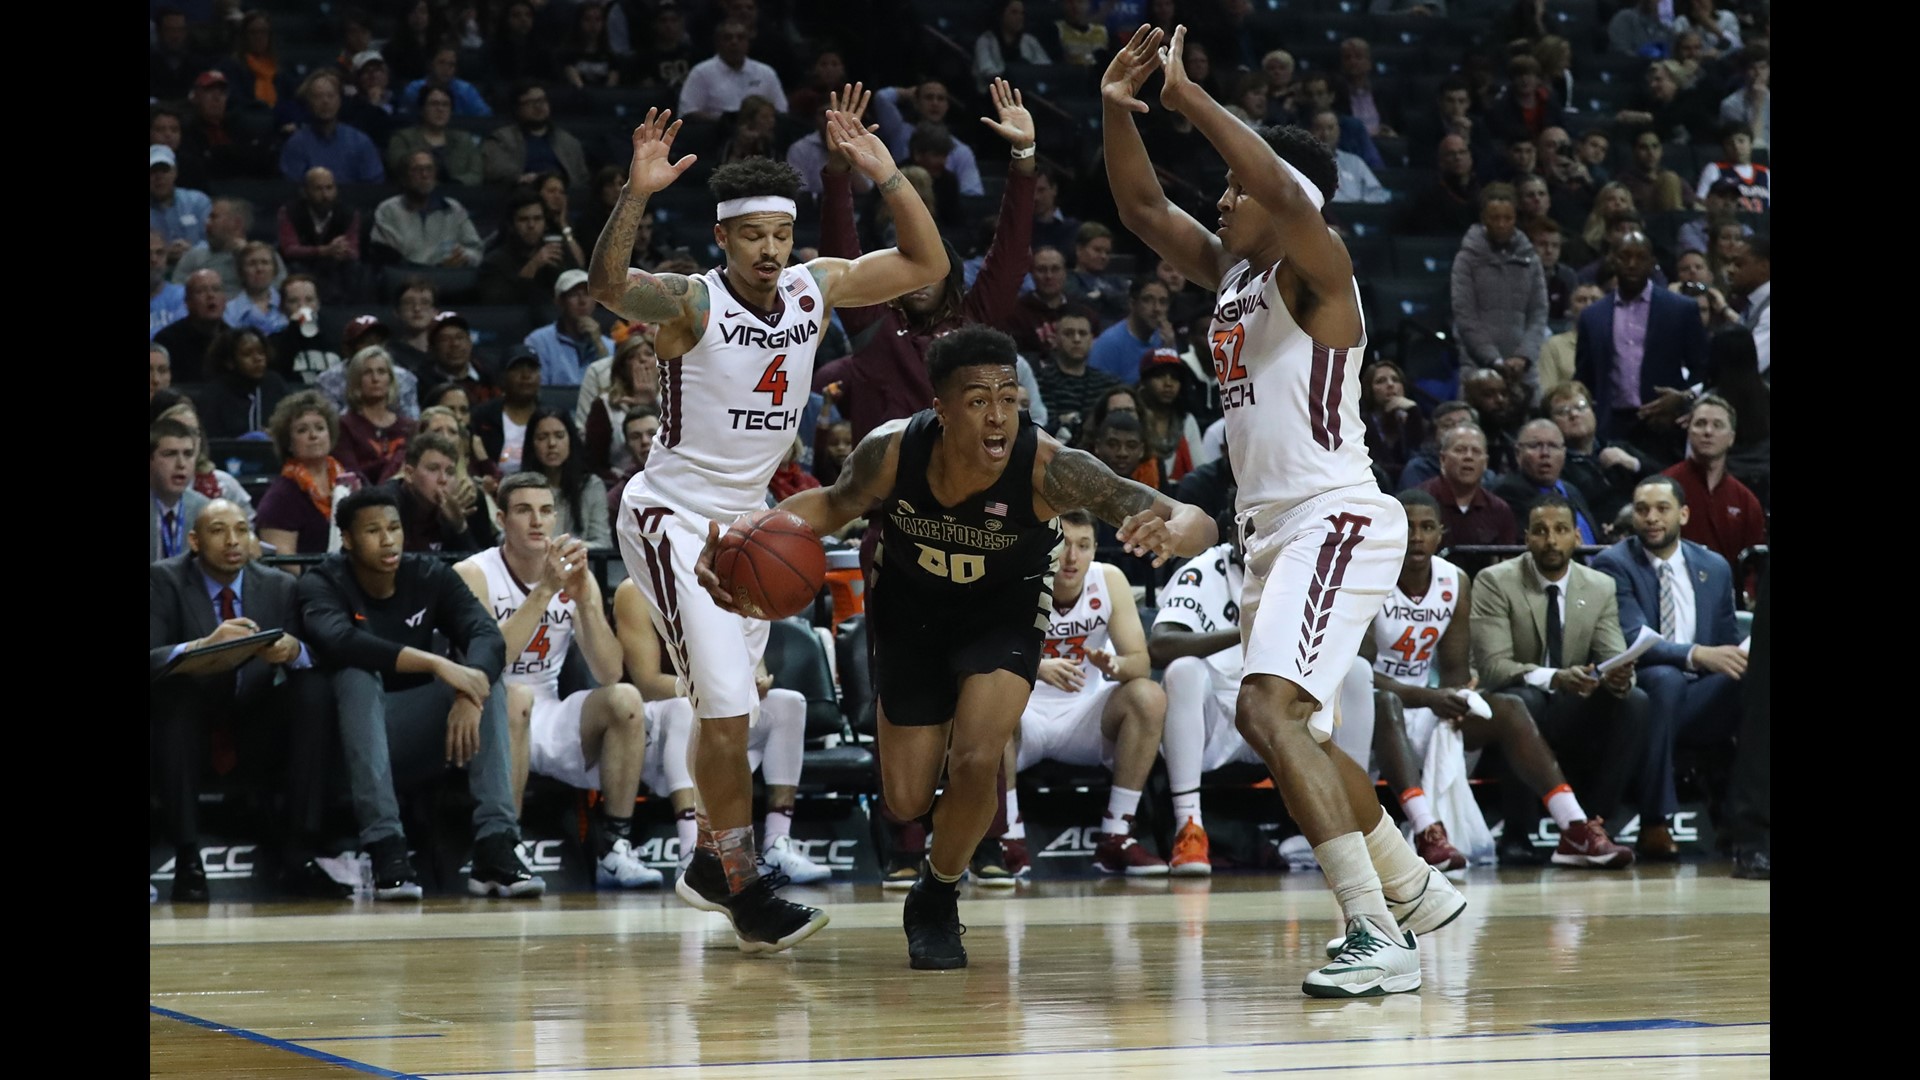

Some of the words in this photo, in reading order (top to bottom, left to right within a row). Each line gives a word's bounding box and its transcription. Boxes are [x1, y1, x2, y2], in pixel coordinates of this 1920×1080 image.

[719, 319, 818, 349] VIRGINIA
[1212, 322, 1247, 385] 32
[753, 354, 789, 406] 4
[728, 408, 798, 431] TECH
[942, 522, 1018, 550] FOREST
[1391, 625, 1439, 662] 42
